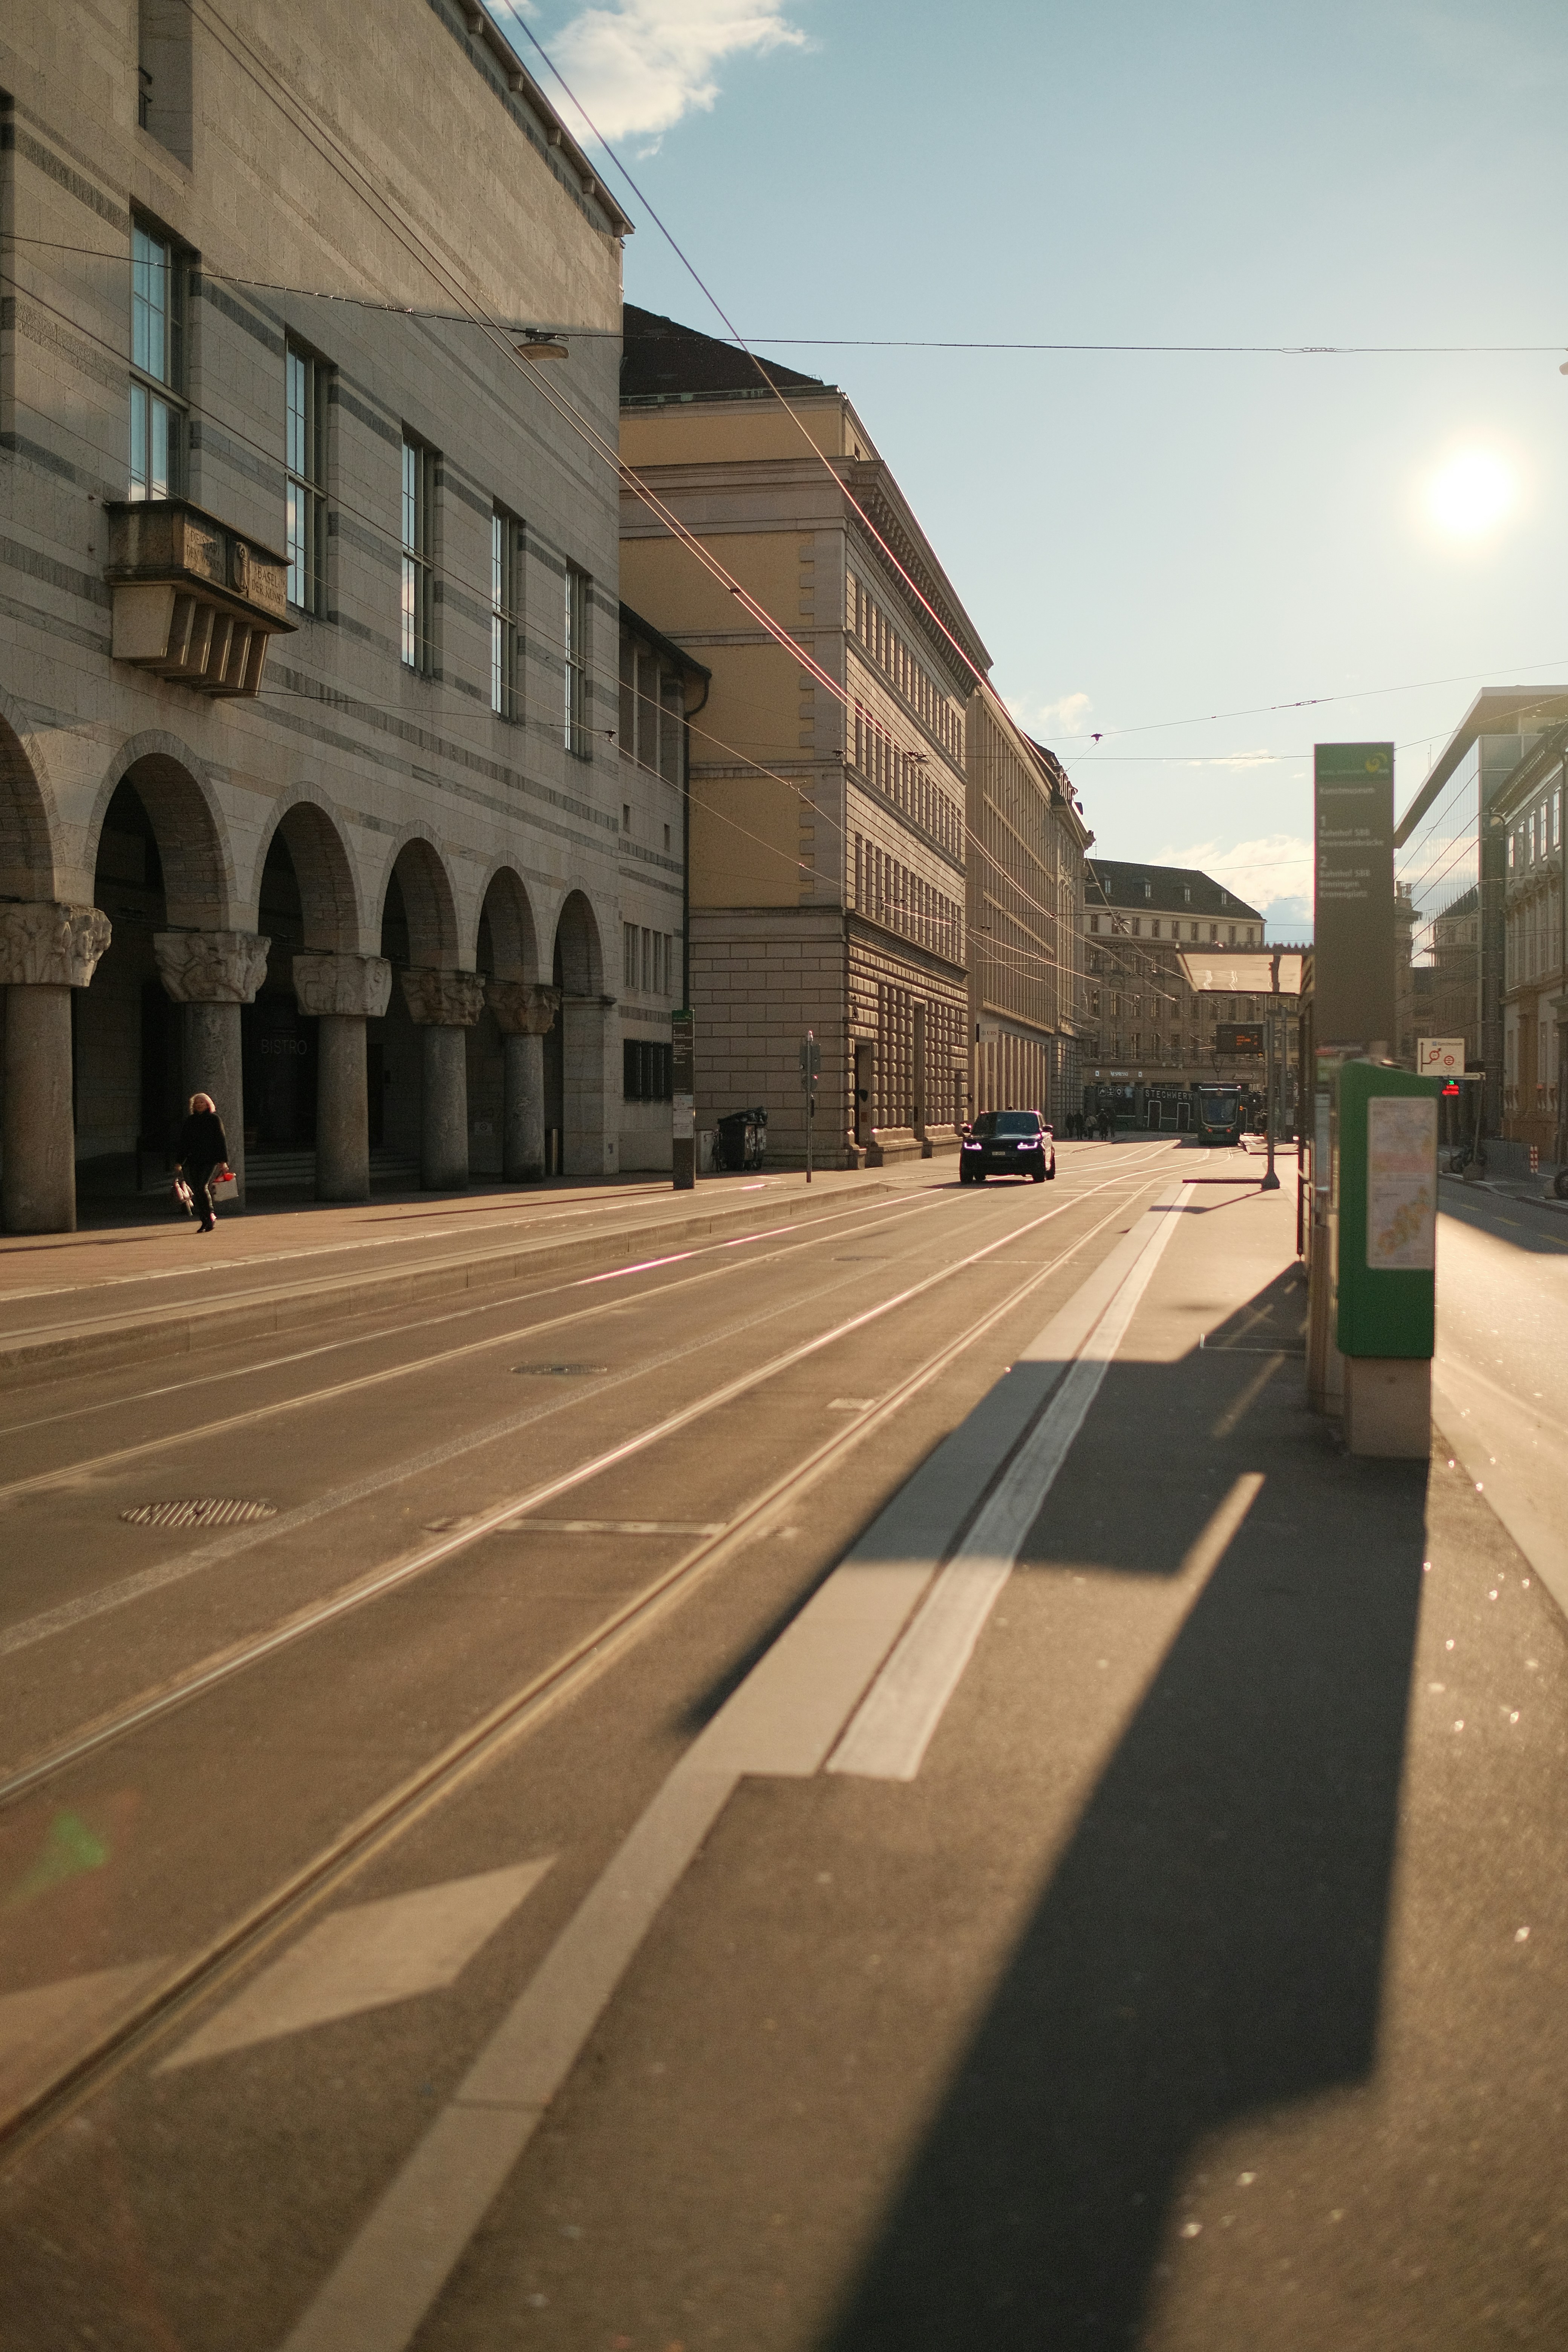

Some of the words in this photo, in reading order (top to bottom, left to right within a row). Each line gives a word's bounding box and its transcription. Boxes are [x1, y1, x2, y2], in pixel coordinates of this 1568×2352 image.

[1320, 815, 1326, 827] 1
[1320, 856, 1327, 868] 2
[1320, 869, 1352, 877] Bahnhof
[261, 1039, 308, 1055] BISTRO
[1145, 1090, 1193, 1100] STECHWERK
